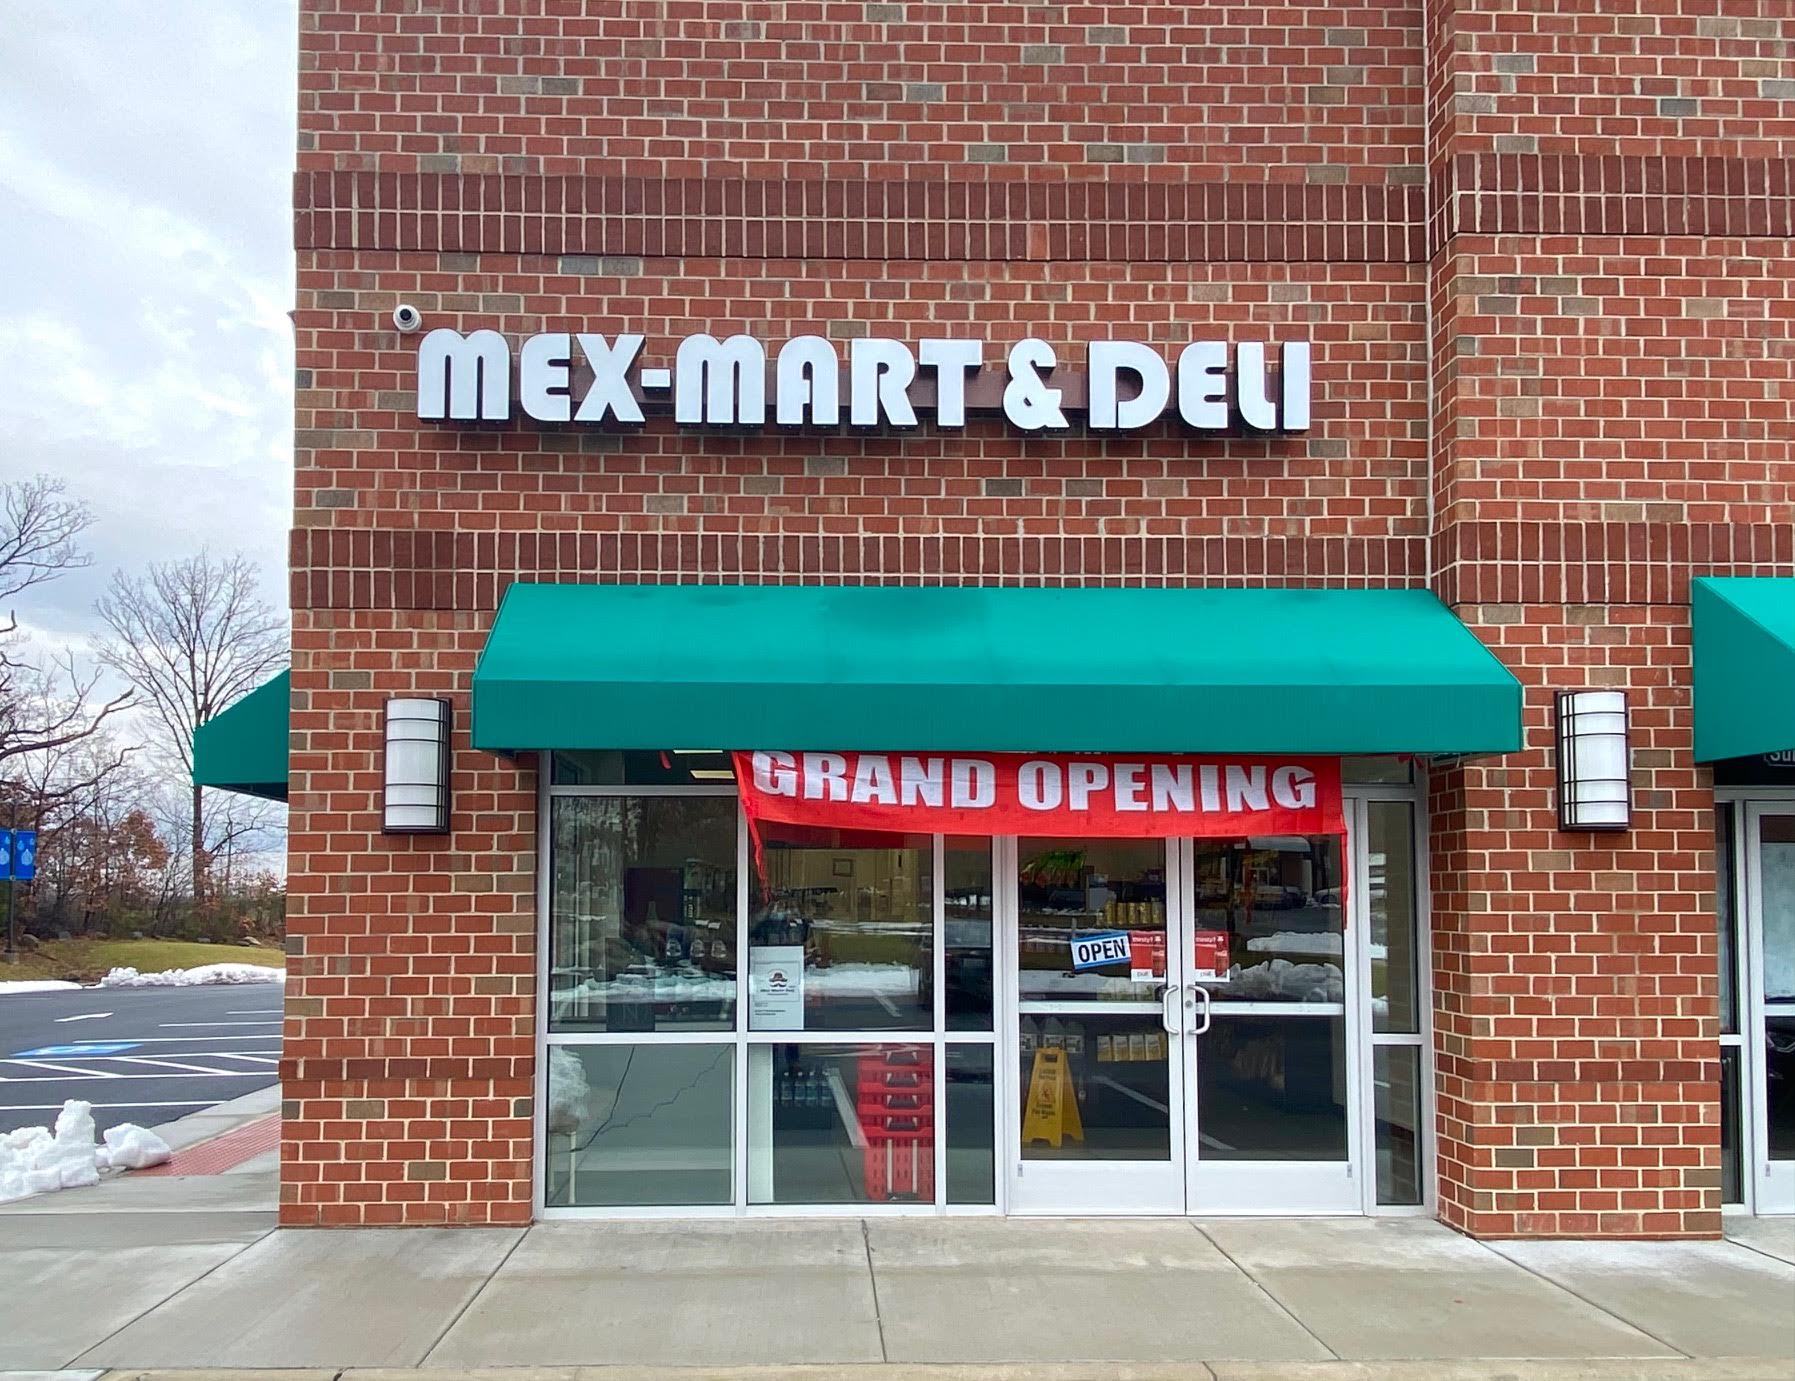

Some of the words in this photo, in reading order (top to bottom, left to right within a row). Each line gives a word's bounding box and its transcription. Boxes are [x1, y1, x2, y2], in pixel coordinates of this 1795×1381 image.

[416, 328, 984, 428] MEX-MART
[1002, 338, 1065, 431] &
[1086, 339, 1311, 432] DELI
[752, 750, 997, 809] GRAND
[1017, 759, 1317, 812] OPENING
[1078, 938, 1127, 963] OPEN
